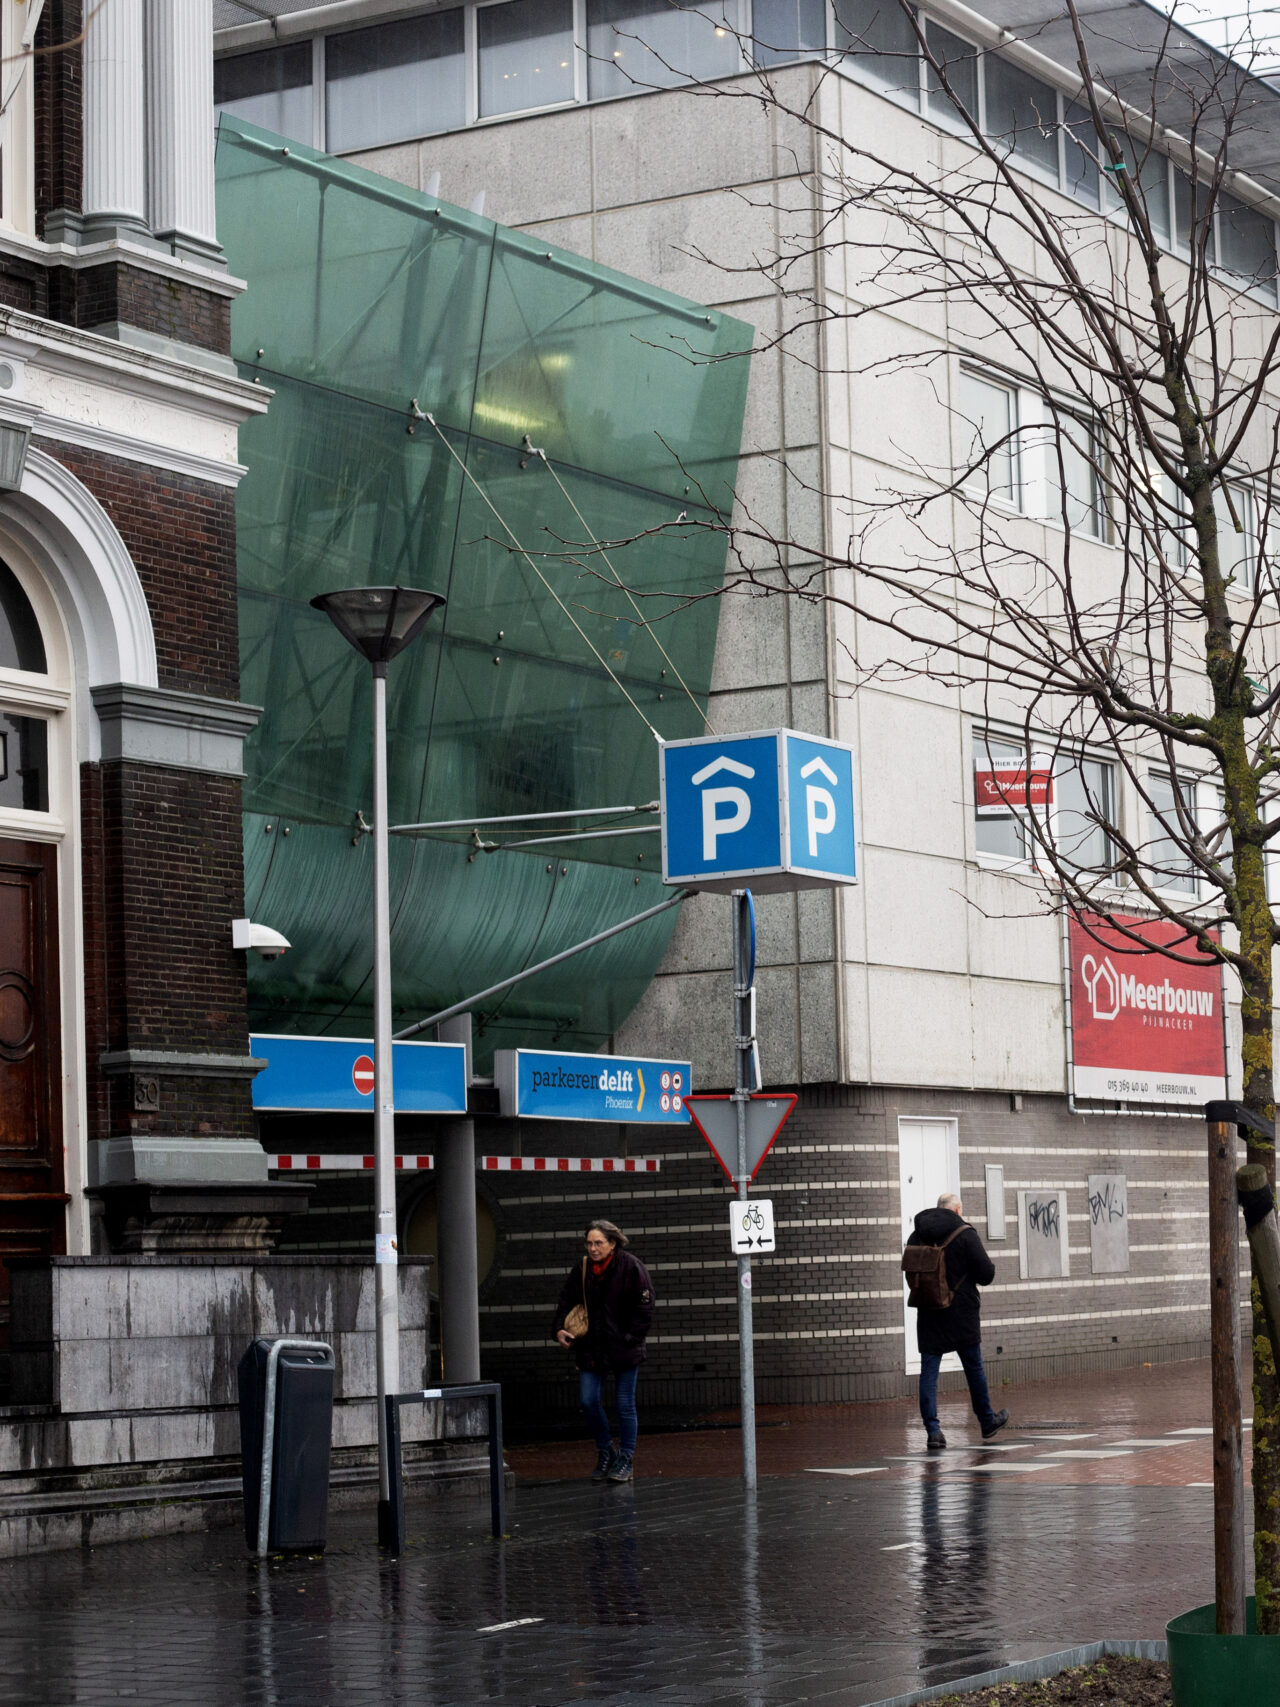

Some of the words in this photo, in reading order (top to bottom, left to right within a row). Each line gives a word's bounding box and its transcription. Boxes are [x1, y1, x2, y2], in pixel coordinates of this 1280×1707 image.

[702, 786, 751, 861] P
[806, 784, 836, 857] P
[1120, 973, 1213, 1017] Meerbouw
[1143, 1015, 1193, 1031] PIJNACKER
[532, 1067, 633, 1092] parkerendelft
[1107, 1080, 1118, 1093] 015
[1119, 1079, 1130, 1093] 369
[1131, 1082, 1140, 1094] 40
[1140, 1082, 1148, 1093] 40
[1156, 1084, 1198, 1096] MEERBOUW.NL
[136, 1082, 158, 1104] 30
[605, 1095, 633, 1109] Phoenix
